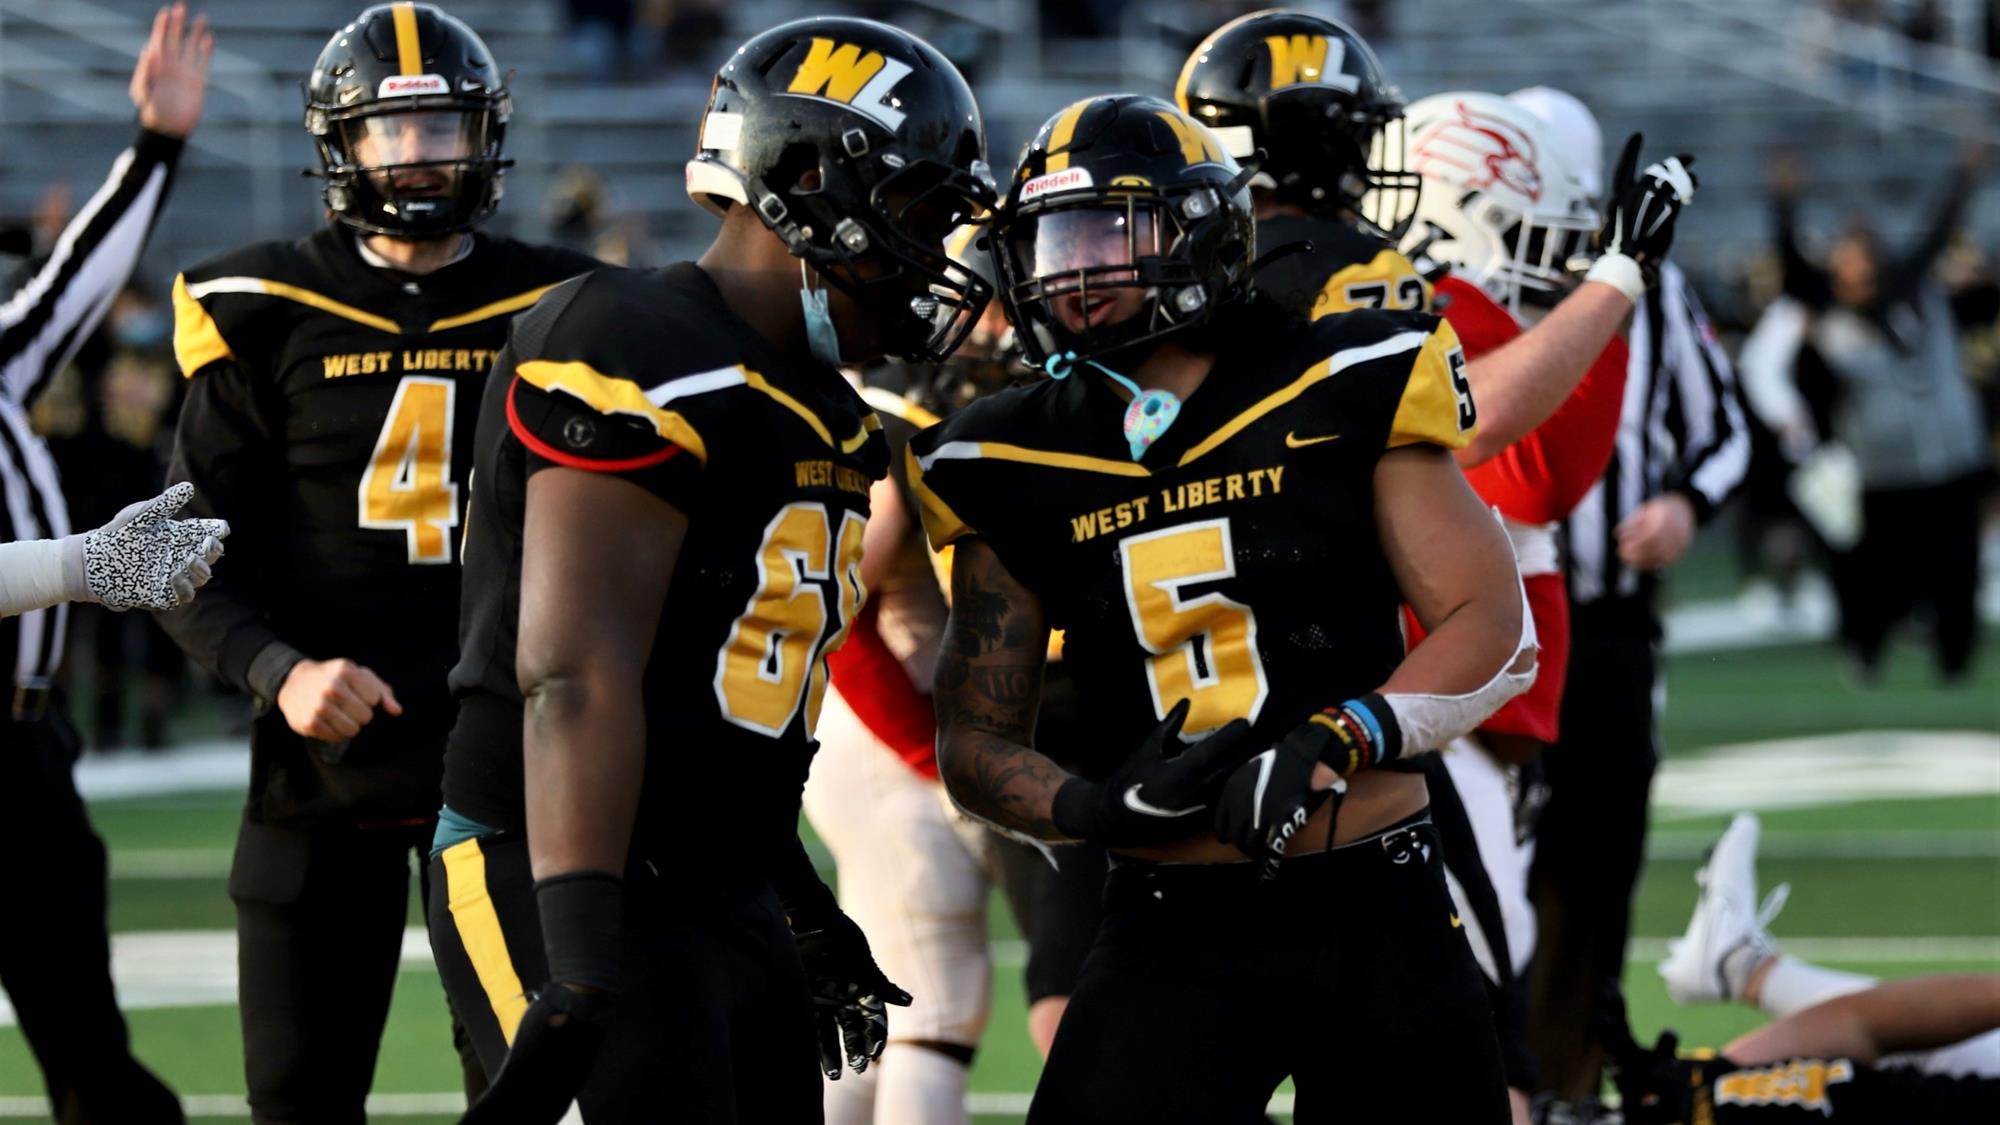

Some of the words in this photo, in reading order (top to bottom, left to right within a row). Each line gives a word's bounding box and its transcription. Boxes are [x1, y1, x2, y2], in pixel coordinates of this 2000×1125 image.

[787, 37, 914, 132] WL
[1264, 34, 1360, 94] WL
[1025, 172, 1080, 195] Riddell
[322, 351, 393, 379] WEST
[1446, 346, 1477, 433] 5
[358, 375, 459, 565] 4
[795, 460, 833, 488] WEST
[1071, 496, 1149, 543] WEST
[1161, 466, 1284, 513] LIBERTY
[1119, 517, 1269, 744] 5
